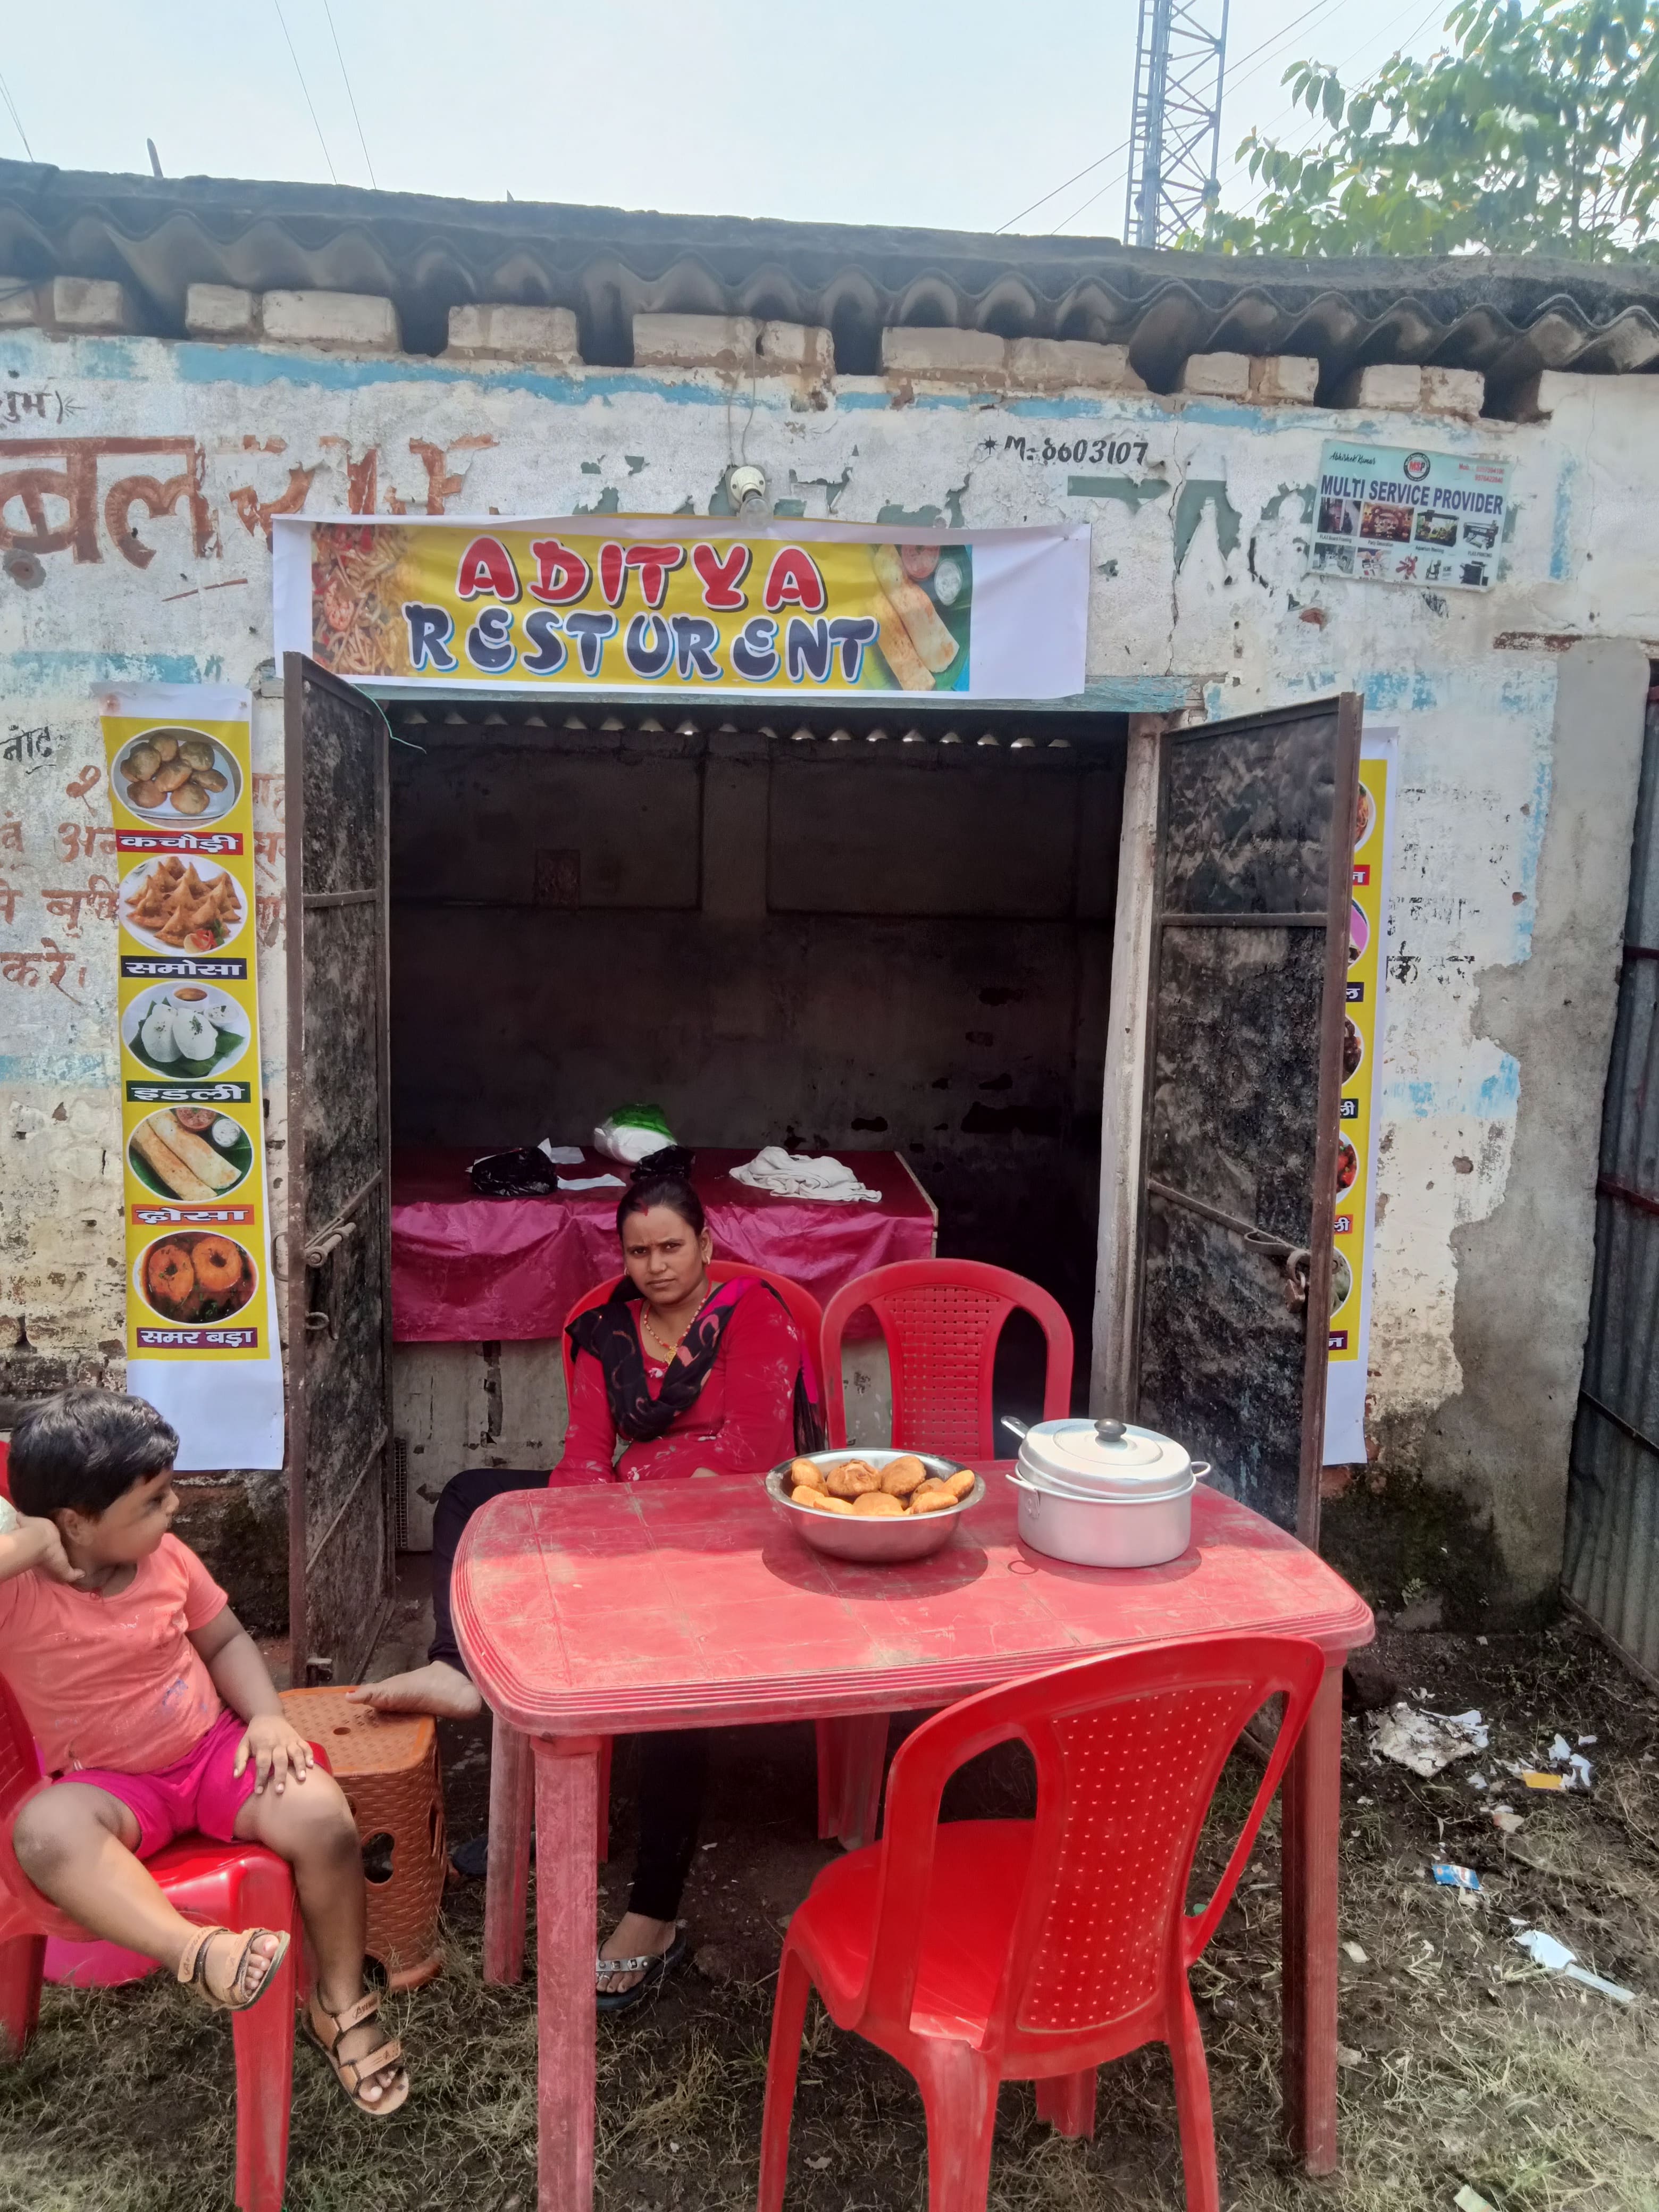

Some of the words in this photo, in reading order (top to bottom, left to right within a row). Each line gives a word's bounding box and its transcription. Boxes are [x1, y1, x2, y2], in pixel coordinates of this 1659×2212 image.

[1410, 460, 1425, 471] MSP
[1320, 474, 1365, 499] MULTI
[1369, 480, 1430, 506] SERVICE
[1433, 488, 1504, 515] PROVIDER
[455, 533, 831, 613] ADITYA
[401, 600, 881, 684] RESTURENT
[119, 834, 239, 853] कचौड़ी
[125, 959, 242, 976] समोसा
[131, 1084, 246, 1101] इडली
[140, 1330, 201, 1344] समर
[205, 1330, 255, 1347] बड़ा
